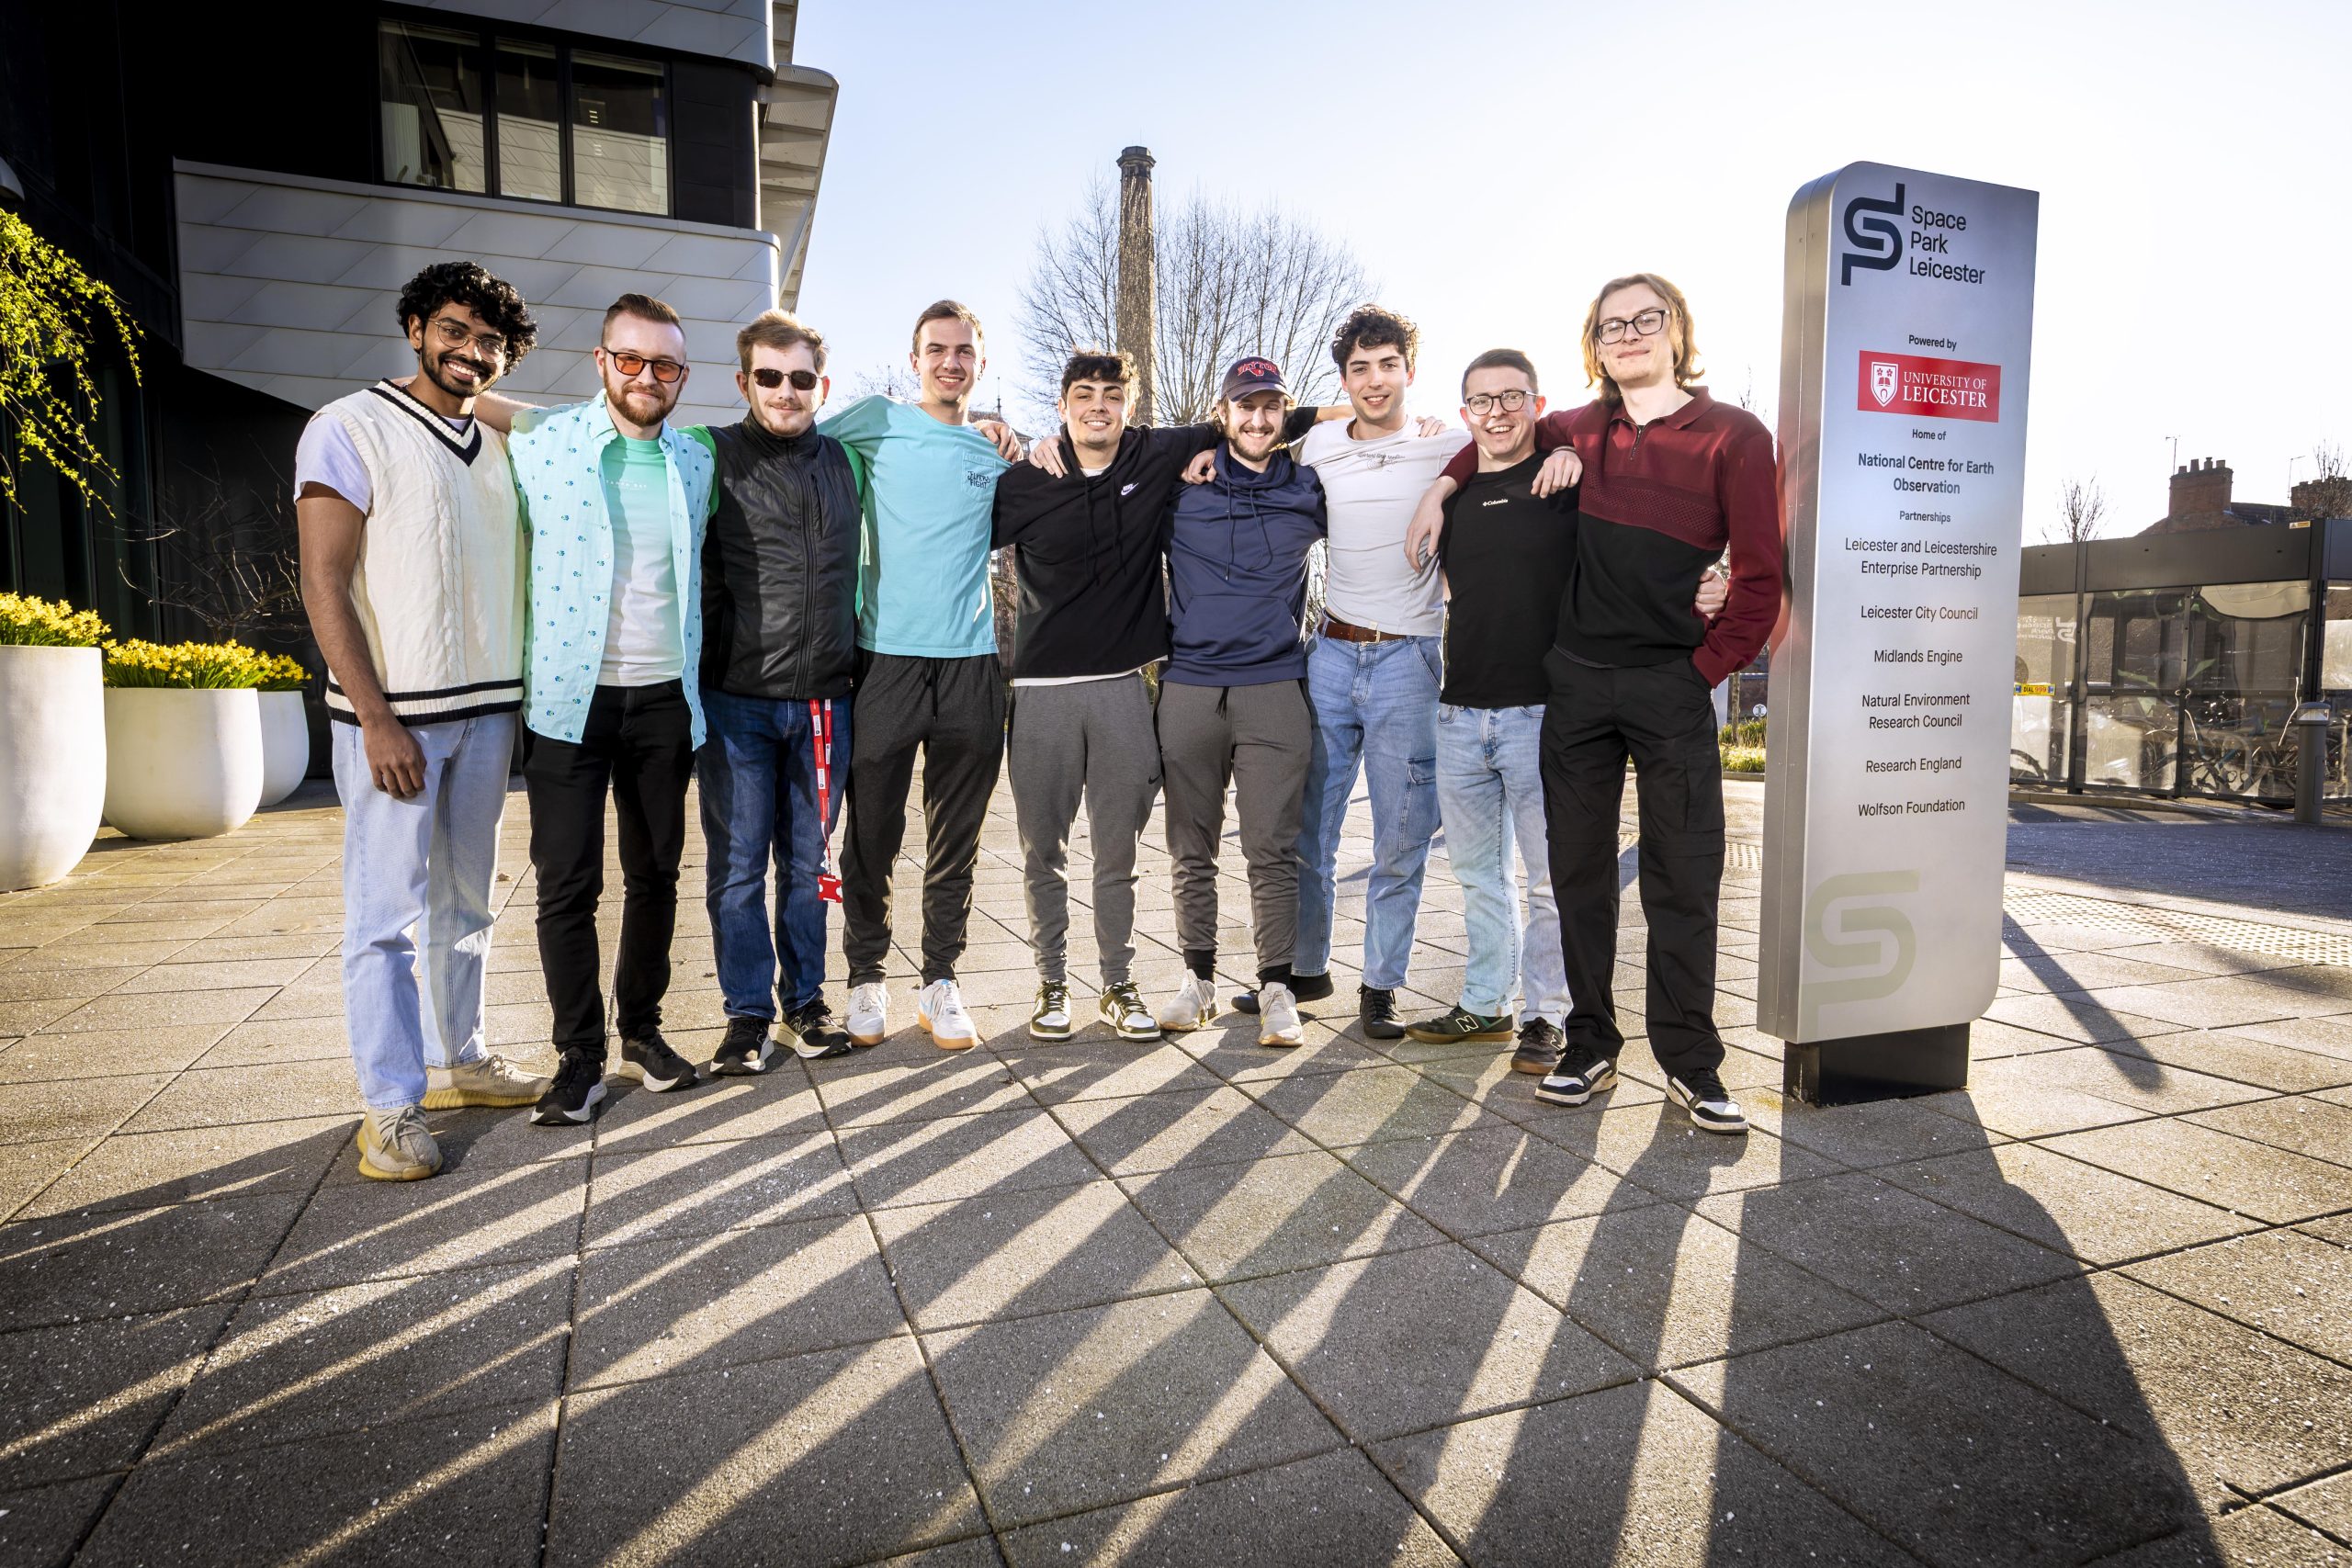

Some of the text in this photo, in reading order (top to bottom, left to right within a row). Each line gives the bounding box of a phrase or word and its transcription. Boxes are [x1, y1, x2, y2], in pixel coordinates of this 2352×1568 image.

[1911, 205, 1967, 231] Space
[1910, 231, 1949, 254] Park
[1909, 256, 1985, 284] Leicester
[1908, 334, 1957, 352] Powered by
[1904, 371, 1987, 389] UNIVERSITY OF
[1903, 385, 1987, 408] LEICESTER
[1912, 428, 1947, 441] Home of
[1858, 453, 1995, 475] National Centre for Earth
[1893, 478, 1961, 494] Observation
[1899, 510, 1951, 525] Partnerships
[1845, 536, 1997, 556] Leicester and Leicestershire
[1861, 560, 1982, 580] Enterprise Partnership
[1860, 605, 1978, 623] Leicester City Council
[1874, 649, 1962, 666] Midlands Engine
[1861, 694, 1970, 707] Natural Environment
[1869, 714, 1962, 728] Research Council
[1866, 757, 1962, 773] Research England
[1858, 799, 1965, 817] Wolfson Foundation
